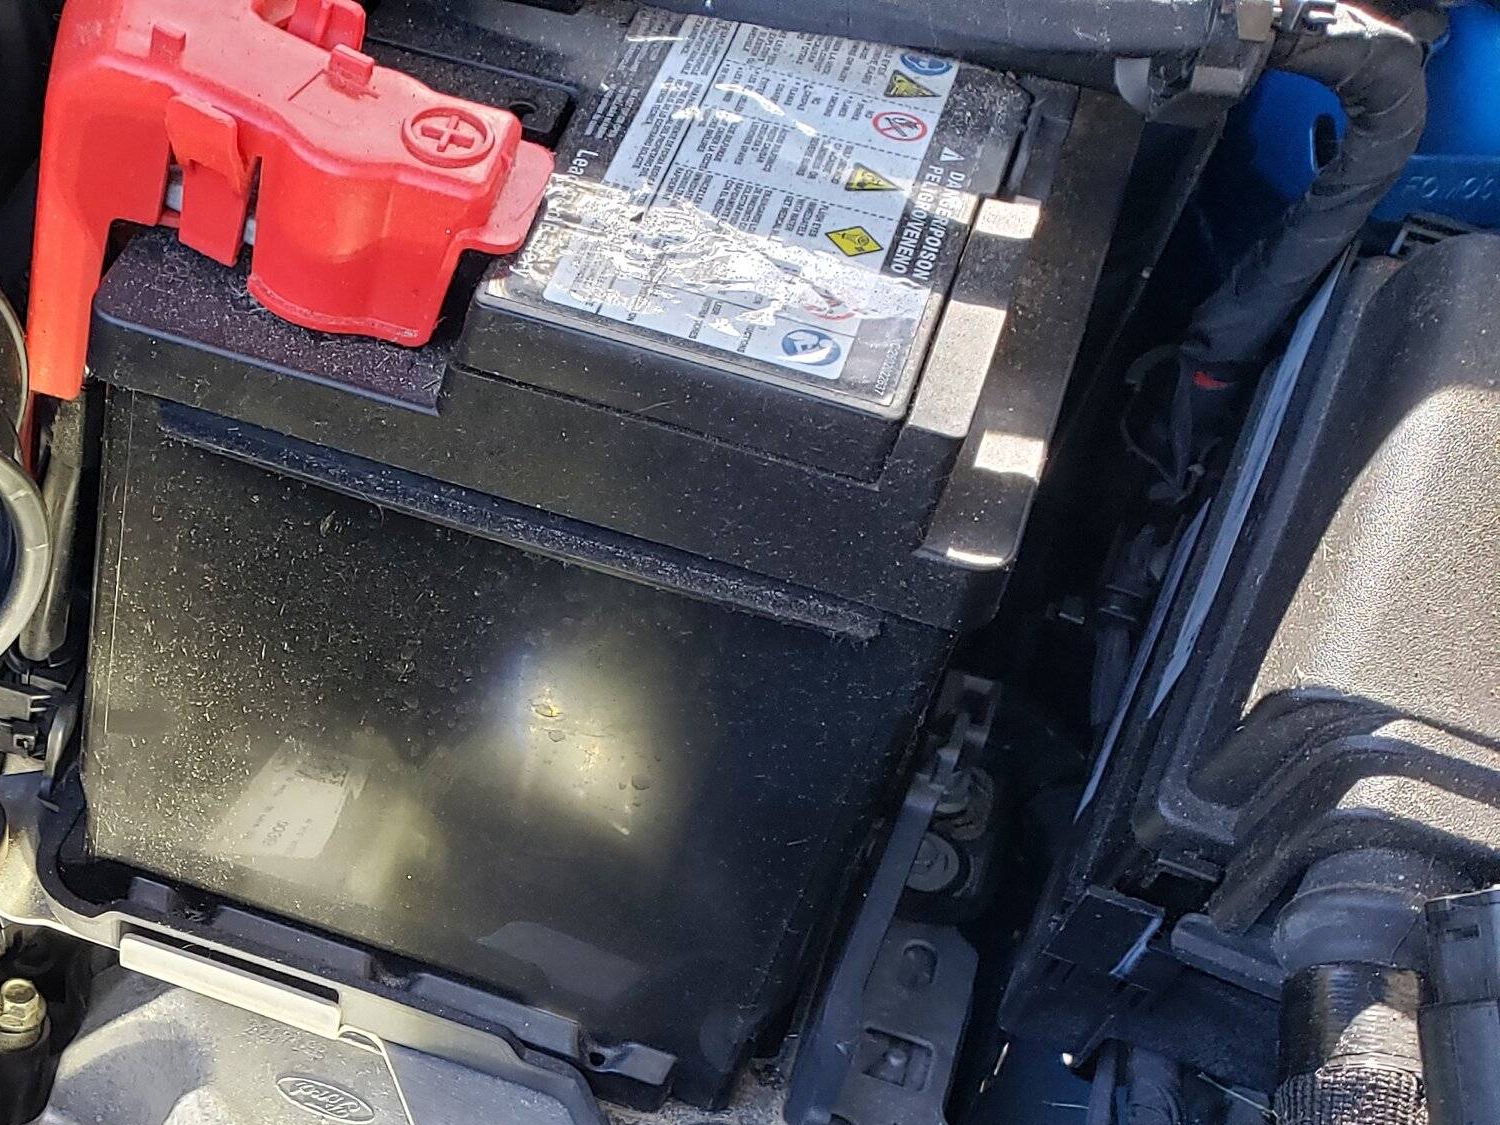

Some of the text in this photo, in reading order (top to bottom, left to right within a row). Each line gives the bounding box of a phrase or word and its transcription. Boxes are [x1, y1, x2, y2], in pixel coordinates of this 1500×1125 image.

[890, 165, 944, 274] PELIGRO/VENENO
[914, 171, 965, 280] DANGER/POISON
[288, 1083, 359, 1119] Ford
